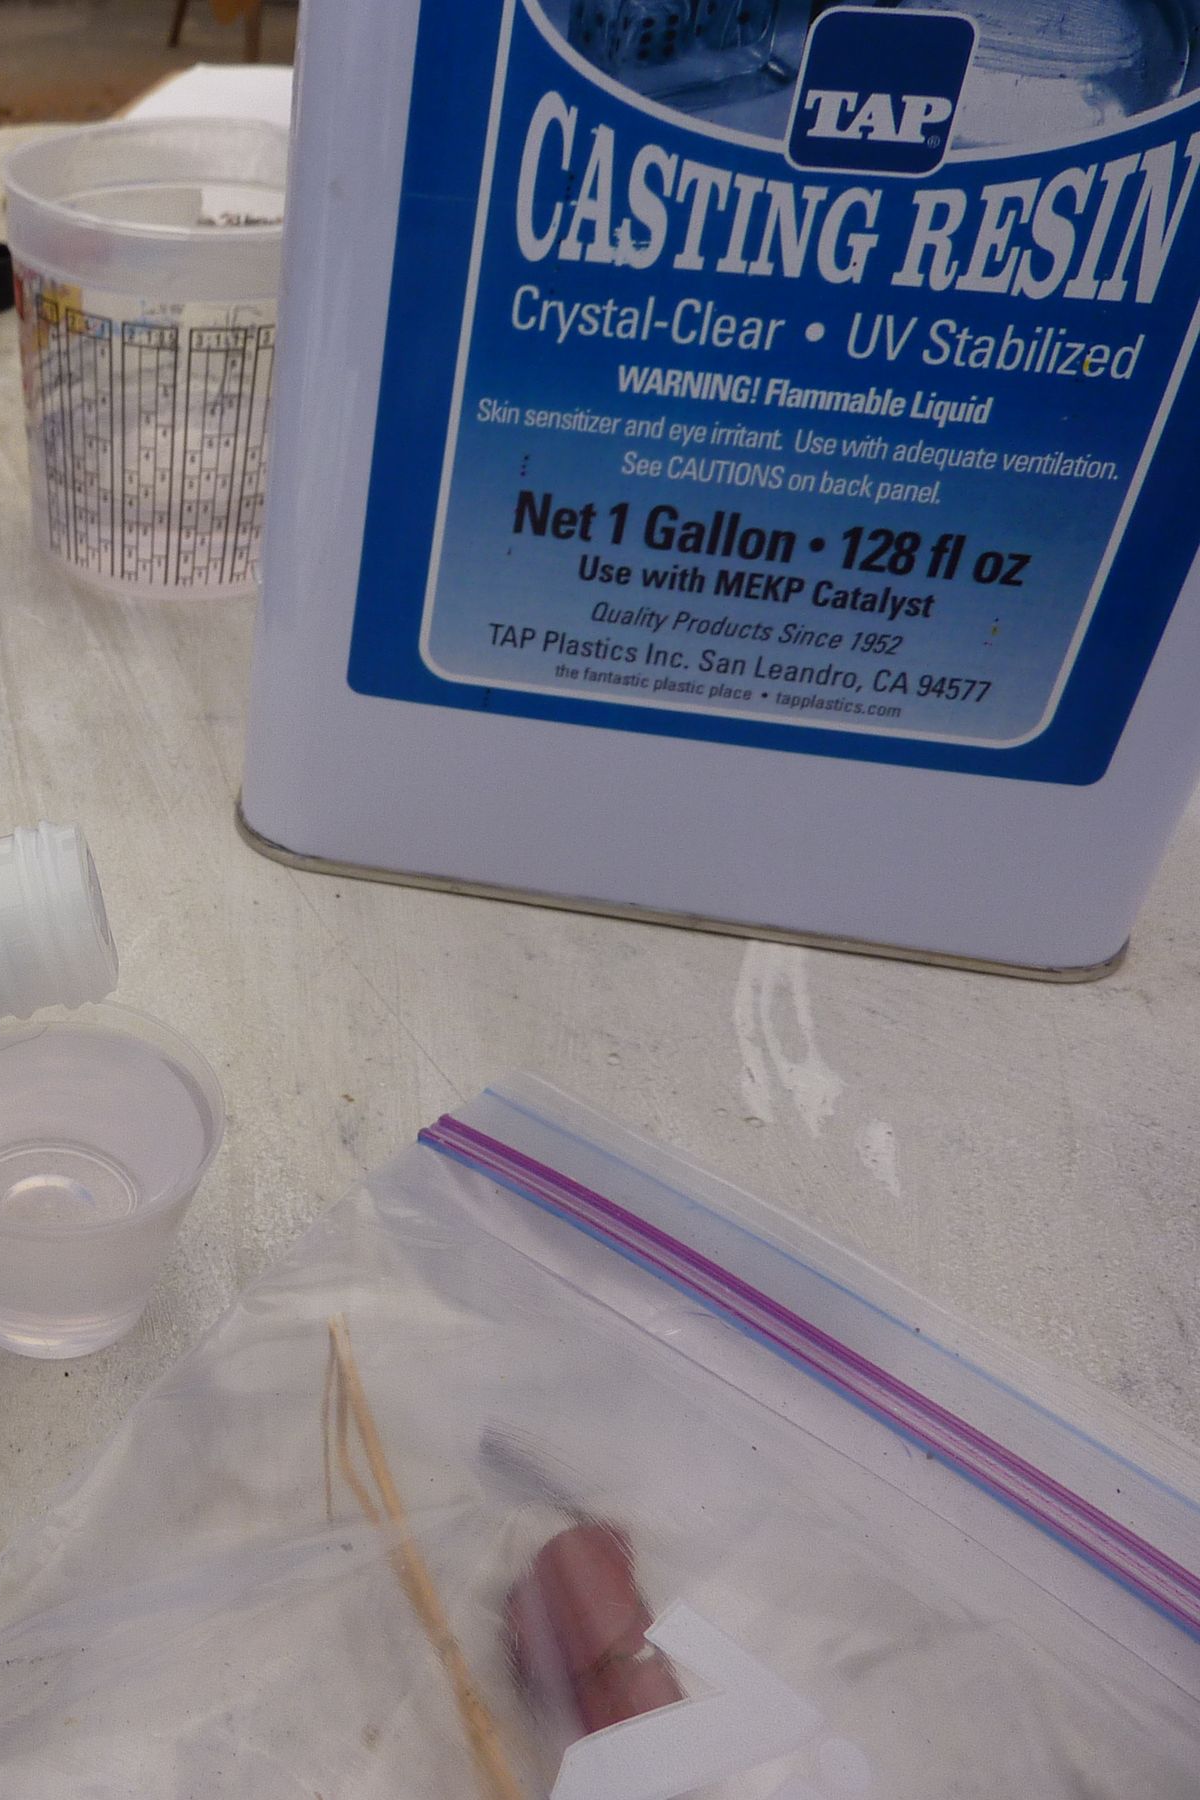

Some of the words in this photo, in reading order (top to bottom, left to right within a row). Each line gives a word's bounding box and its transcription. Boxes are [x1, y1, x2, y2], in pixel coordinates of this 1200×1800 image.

[804, 89, 952, 143] TAP
[515, 90, 882, 285] CASTING
[891, 130, 1200, 303] RESIN
[511, 284, 786, 350] Crystal-Clear
[847, 312, 919, 361] UV
[922, 318, 1146, 380] Stabilized
[617, 364, 762, 404] WARNING!
[764, 377, 906, 417] Flammable
[909, 390, 994, 428] Liquid
[476, 397, 520, 425] Skin
[523, 406, 621, 434] sensitizer
[624, 416, 666, 439] and
[668, 424, 706, 447] eye
[709, 420, 783, 450] irritant.
[794, 428, 837, 455] Use
[841, 434, 889, 460] with
[892, 440, 997, 471] adequate
[1002, 451, 1119, 480] ventilation.
[620, 451, 663, 477] See
[666, 455, 786, 490] CAUTIONS
[787, 472, 816, 493] on
[818, 470, 873, 498] back
[874, 480, 942, 505] panel.
[512, 489, 596, 542] Net
[608, 502, 630, 545] 1
[643, 504, 797, 563] Gallon
[841, 525, 921, 576] 128
[926, 532, 967, 581] fl
[972, 550, 1032, 587] oz
[577, 554, 632, 585] Use
[641, 564, 705, 593] with
[713, 569, 805, 604] MEKP
[811, 580, 935, 621] Catalyst
[590, 601, 669, 634] Quality
[672, 610, 774, 642] Products
[777, 622, 843, 649] Since
[850, 631, 903, 656] 1952
[488, 623, 536, 649] TAP
[542, 630, 637, 663] Plastics
[645, 643, 689, 670] Inc.
[697, 648, 746, 676] San
[753, 655, 863, 693] Leandro,
[872, 669, 908, 694] CA
[916, 674, 992, 703] 94577
[554, 663, 579, 681] the
[582, 666, 650, 689] fantastic
[653, 676, 705, 696] plastic
[707, 682, 752, 702] place
[775, 690, 902, 718] tapplastics.com
